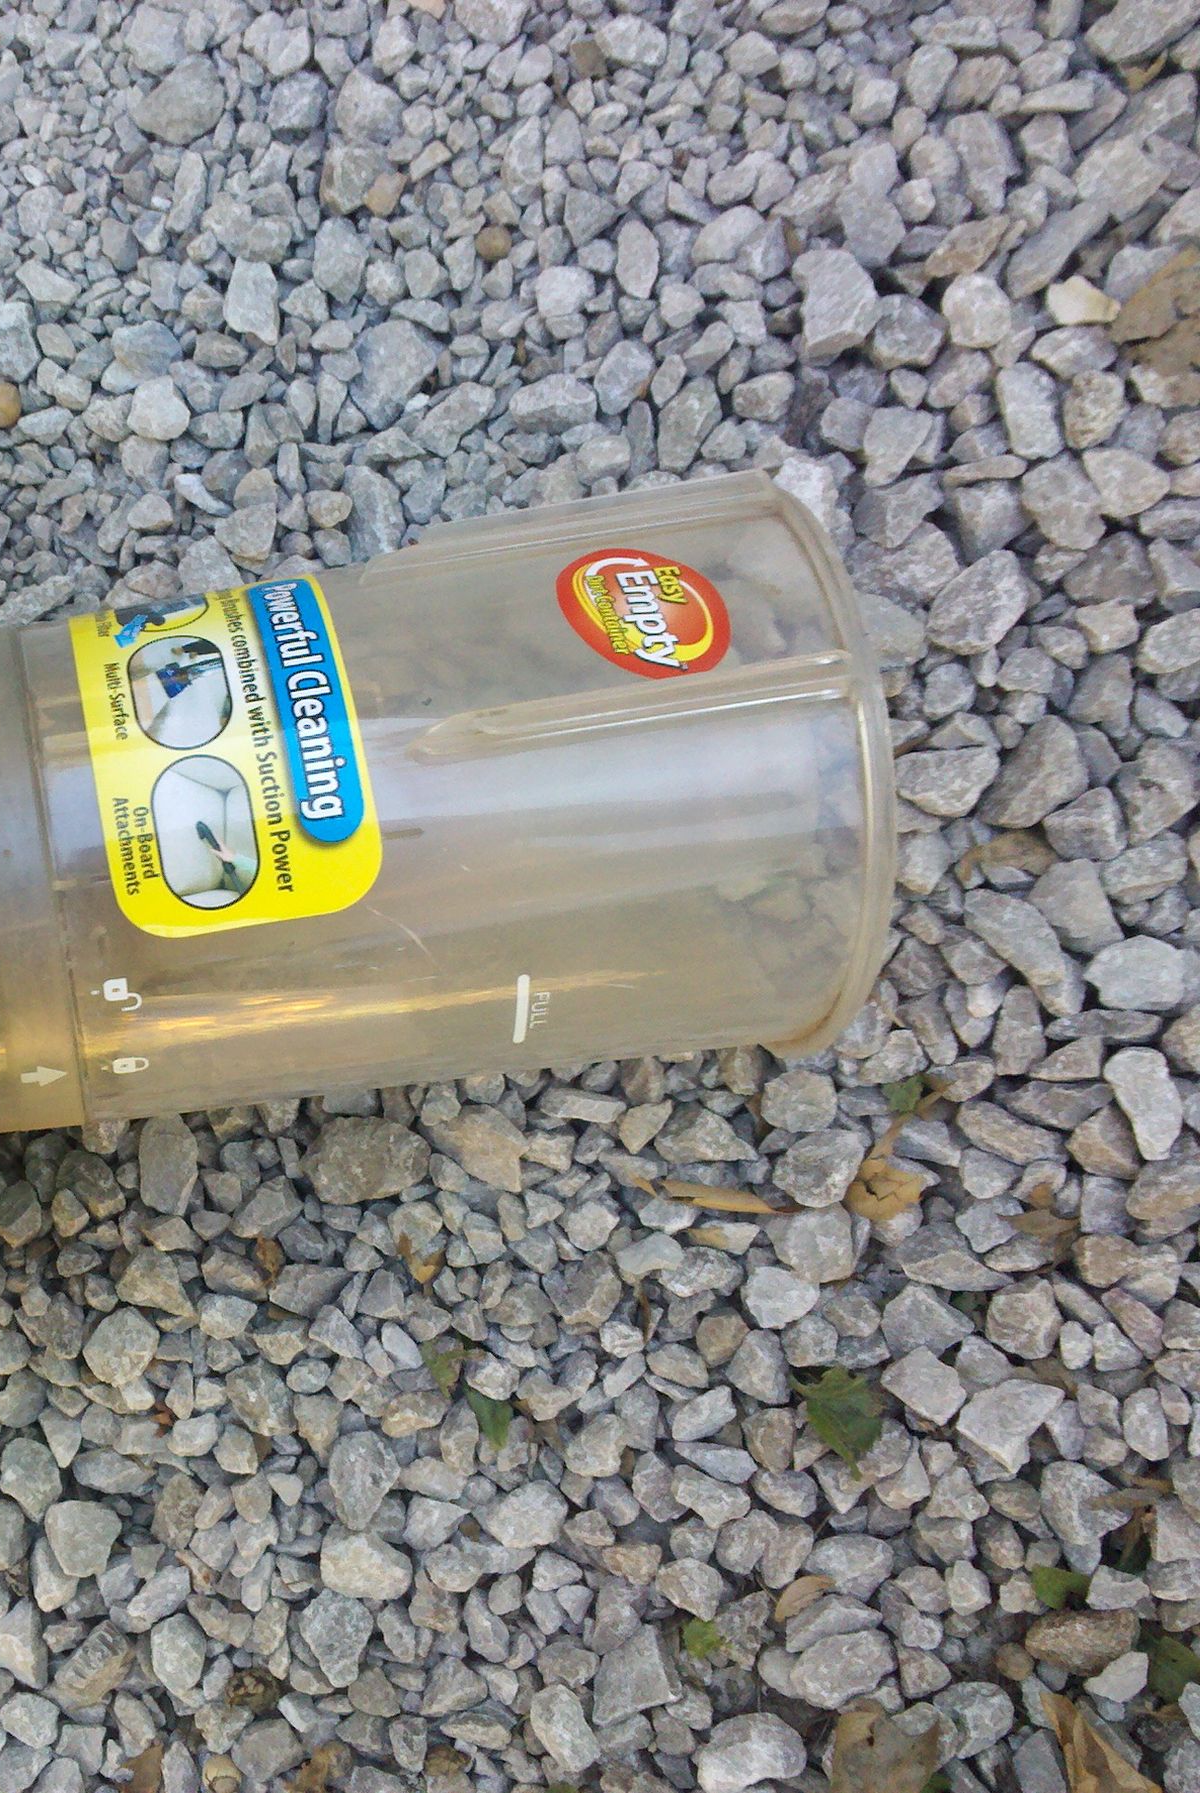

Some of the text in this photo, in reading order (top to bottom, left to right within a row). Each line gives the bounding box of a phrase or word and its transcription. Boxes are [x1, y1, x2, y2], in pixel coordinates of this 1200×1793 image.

[615, 570, 680, 667] Empty
[654, 566, 688, 604] Easy
[593, 595, 629, 655] Container
[104, 662, 130, 741] Multi-Surface
[230, 635, 261, 703] combined
[261, 583, 347, 820] Powerful Cleaning
[248, 707, 274, 747] with
[255, 753, 286, 825] Suction
[112, 797, 141, 895] Attachments
[134, 806, 158, 879] On-Board
[269, 830, 295, 892] Power
[528, 991, 551, 1030] FULL
